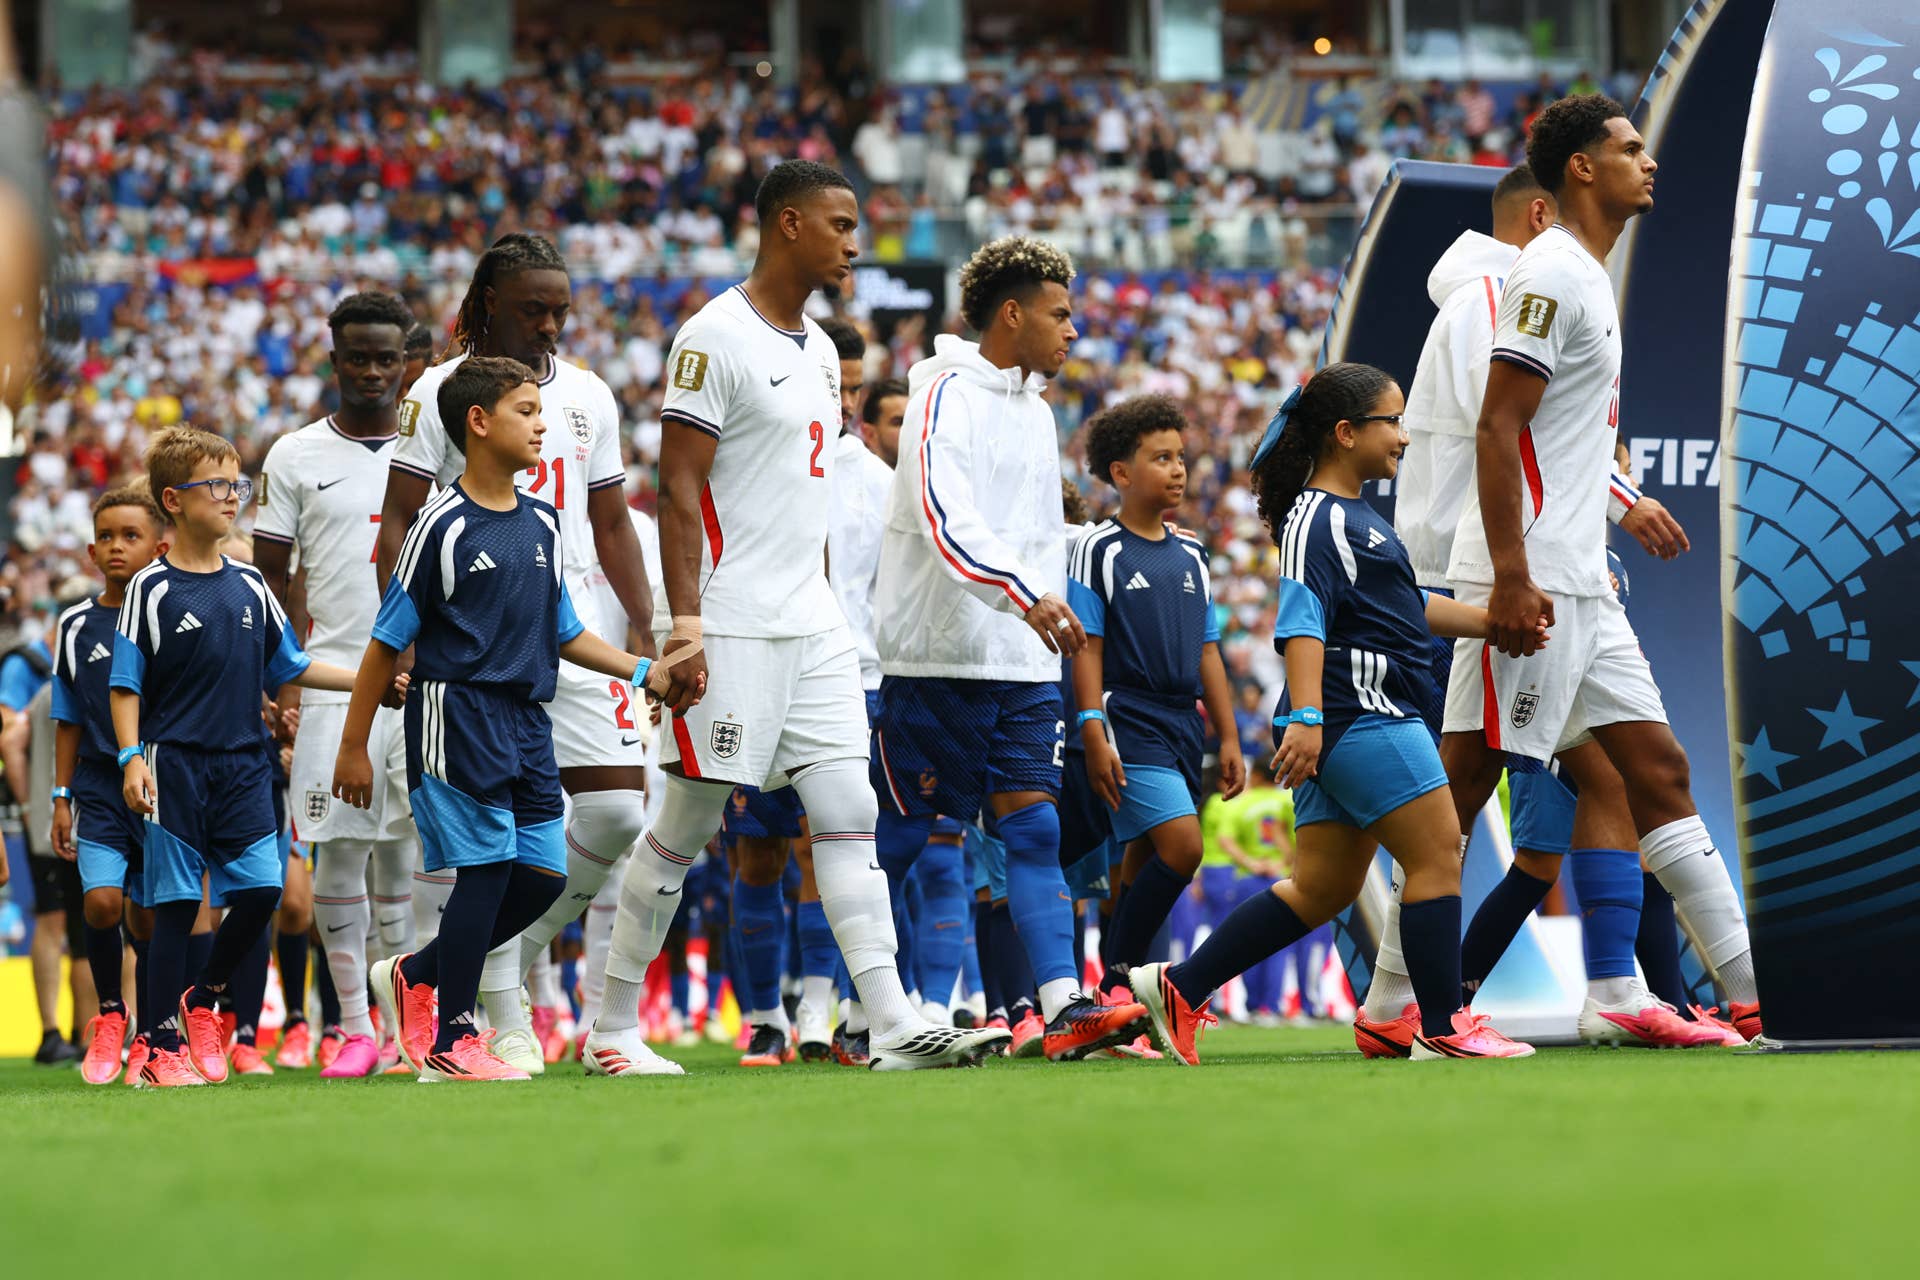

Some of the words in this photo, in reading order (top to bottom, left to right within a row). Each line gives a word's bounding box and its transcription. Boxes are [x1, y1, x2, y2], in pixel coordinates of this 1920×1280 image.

[808, 420, 825, 478] 2
[1629, 438, 1720, 486] FIF
[526, 457, 566, 510] 21
[608, 680, 635, 730] 2
